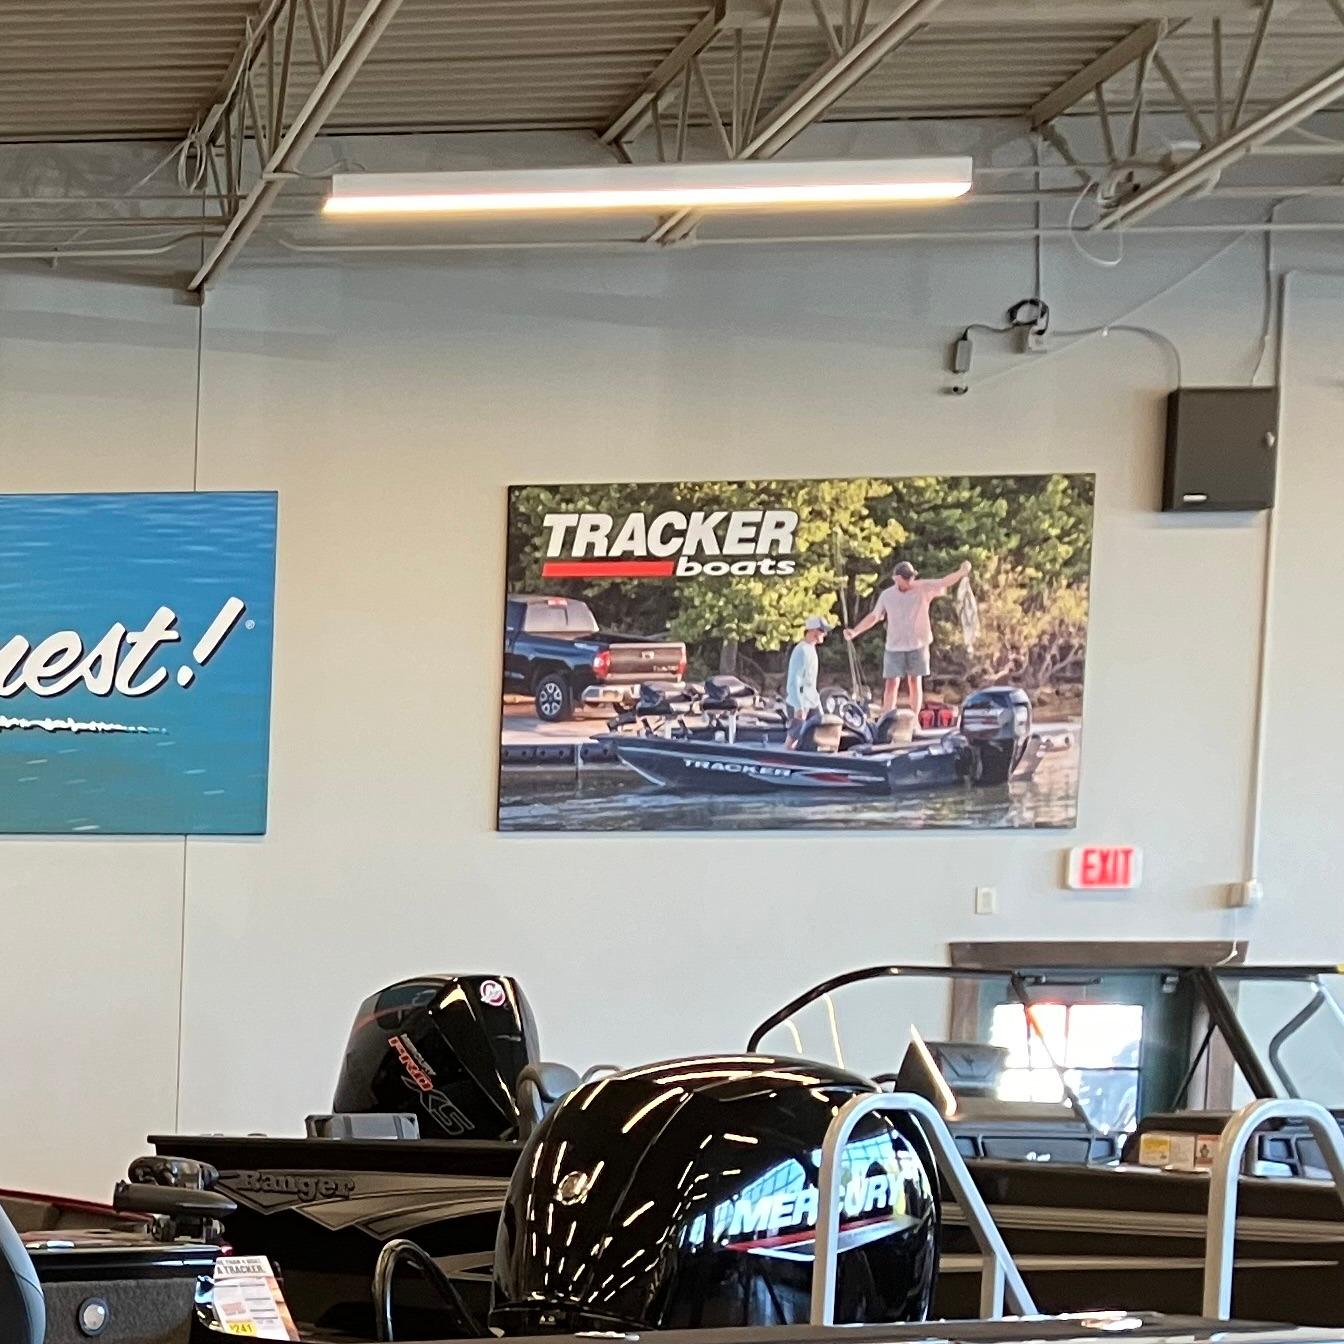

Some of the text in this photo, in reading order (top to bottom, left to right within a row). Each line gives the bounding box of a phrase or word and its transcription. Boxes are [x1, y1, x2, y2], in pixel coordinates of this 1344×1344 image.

[543, 510, 799, 558] TRACKER
[675, 556, 796, 577] boats
[682, 757, 793, 778] TRACKER
[1081, 847, 1135, 886] EXIT
[387, 1035, 434, 1092] PRO
[236, 1169, 356, 1201] Ranger
[726, 1170, 906, 1236] MERURY
